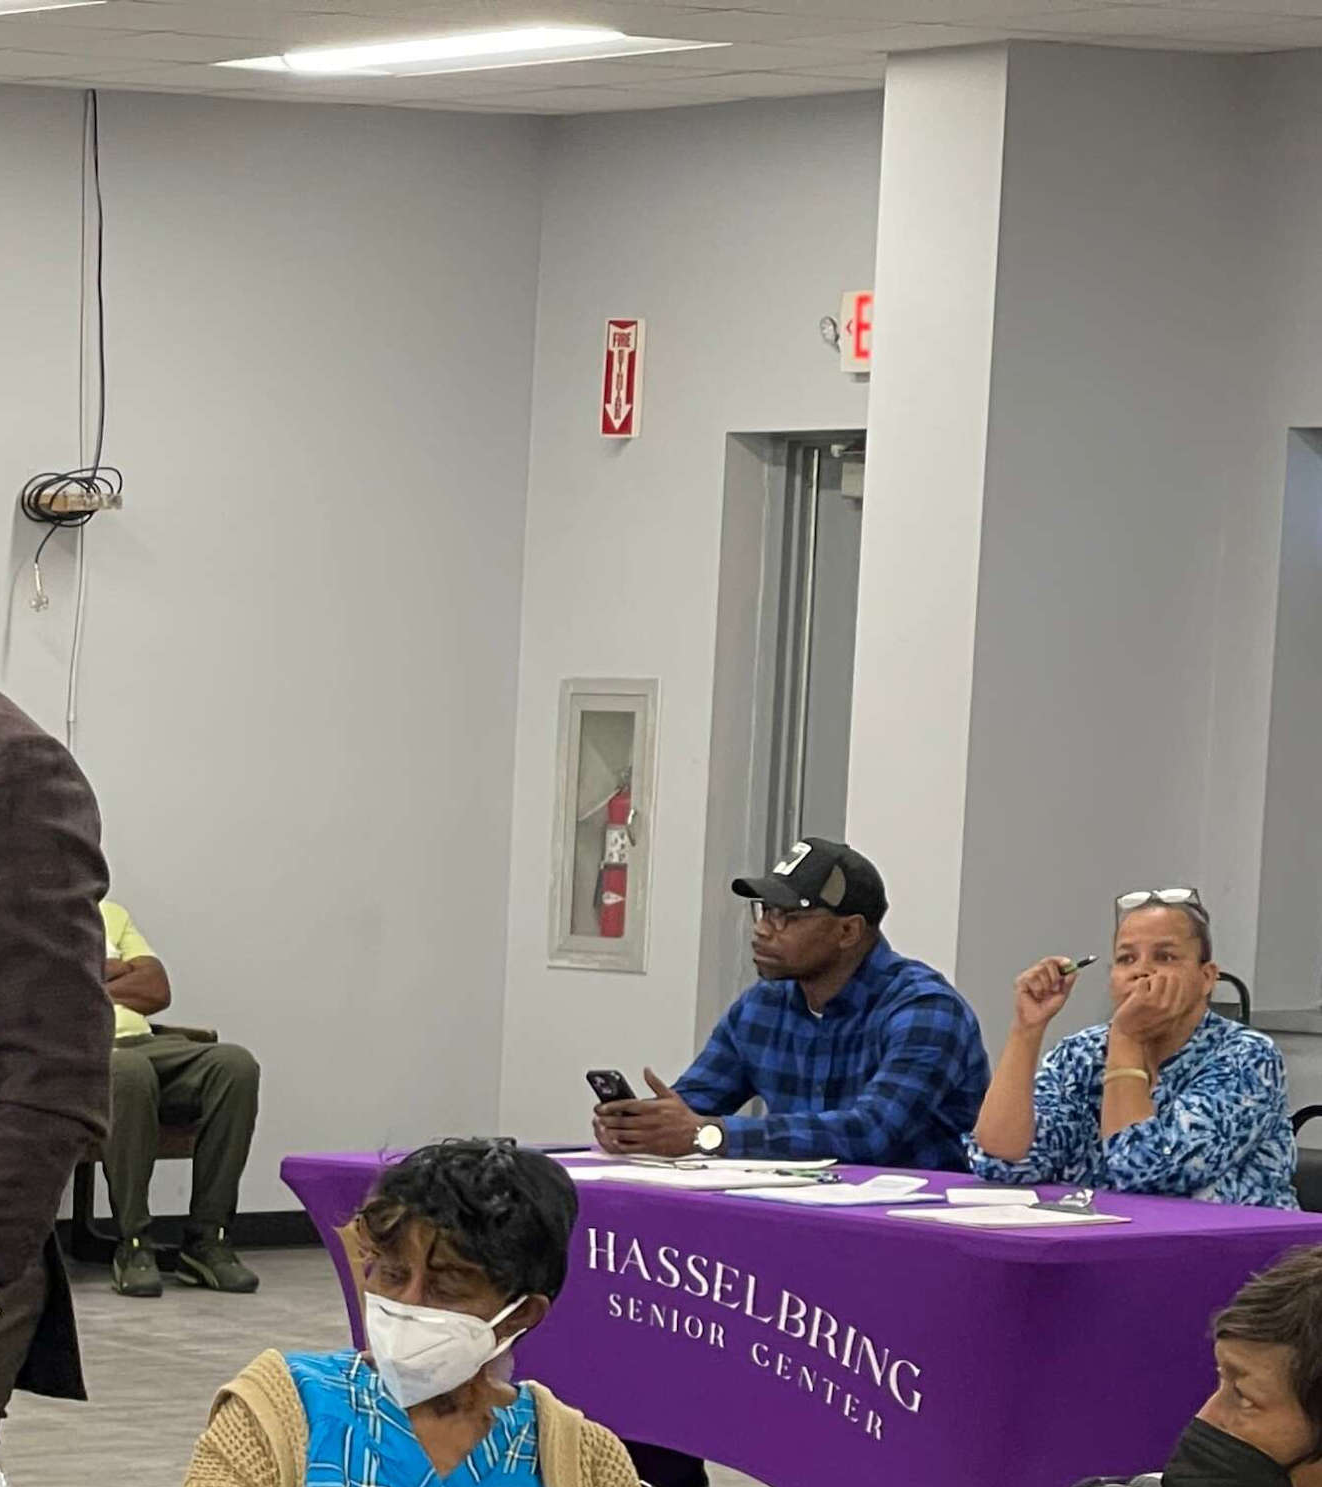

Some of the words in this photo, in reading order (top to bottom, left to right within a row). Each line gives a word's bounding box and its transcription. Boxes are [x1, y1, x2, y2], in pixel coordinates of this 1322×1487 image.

[585, 1226, 923, 1414] HASSELBRING
[607, 1292, 727, 1348] SENIOR
[751, 1341, 885, 1441] CENTER
